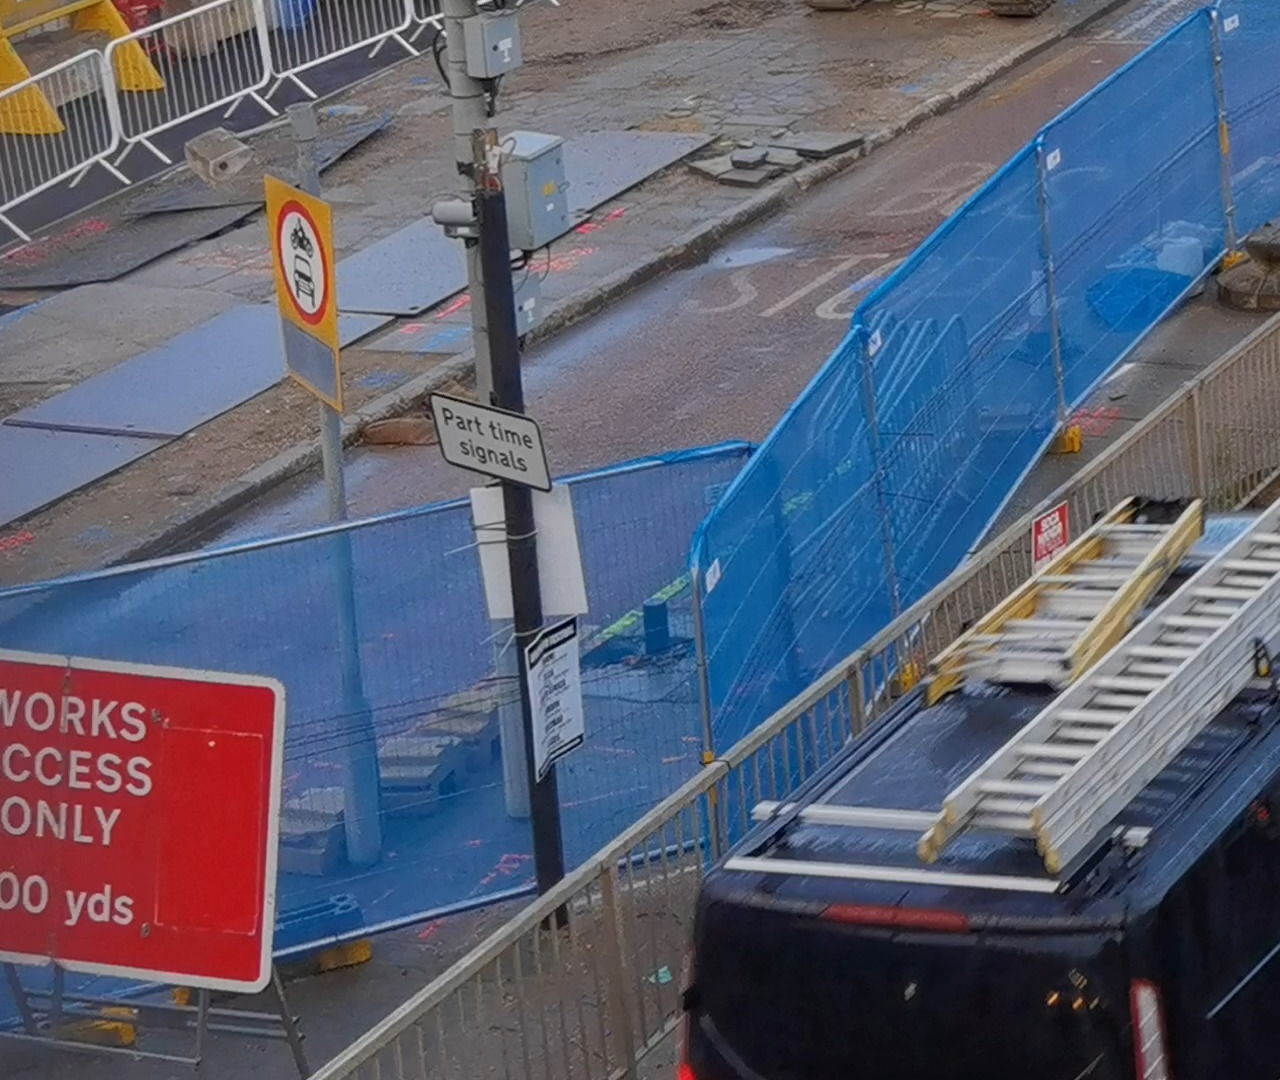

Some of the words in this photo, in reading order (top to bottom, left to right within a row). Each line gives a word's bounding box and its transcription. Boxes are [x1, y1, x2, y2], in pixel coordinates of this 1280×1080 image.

[441, 406, 485, 437] Part
[489, 419, 534, 450] time
[459, 438, 528, 472] signals
[2, 742, 153, 797] CCESS
[0, 795, 122, 846] ONLY
[0, 872, 49, 914] 00
[64, 884, 135, 927] yds
